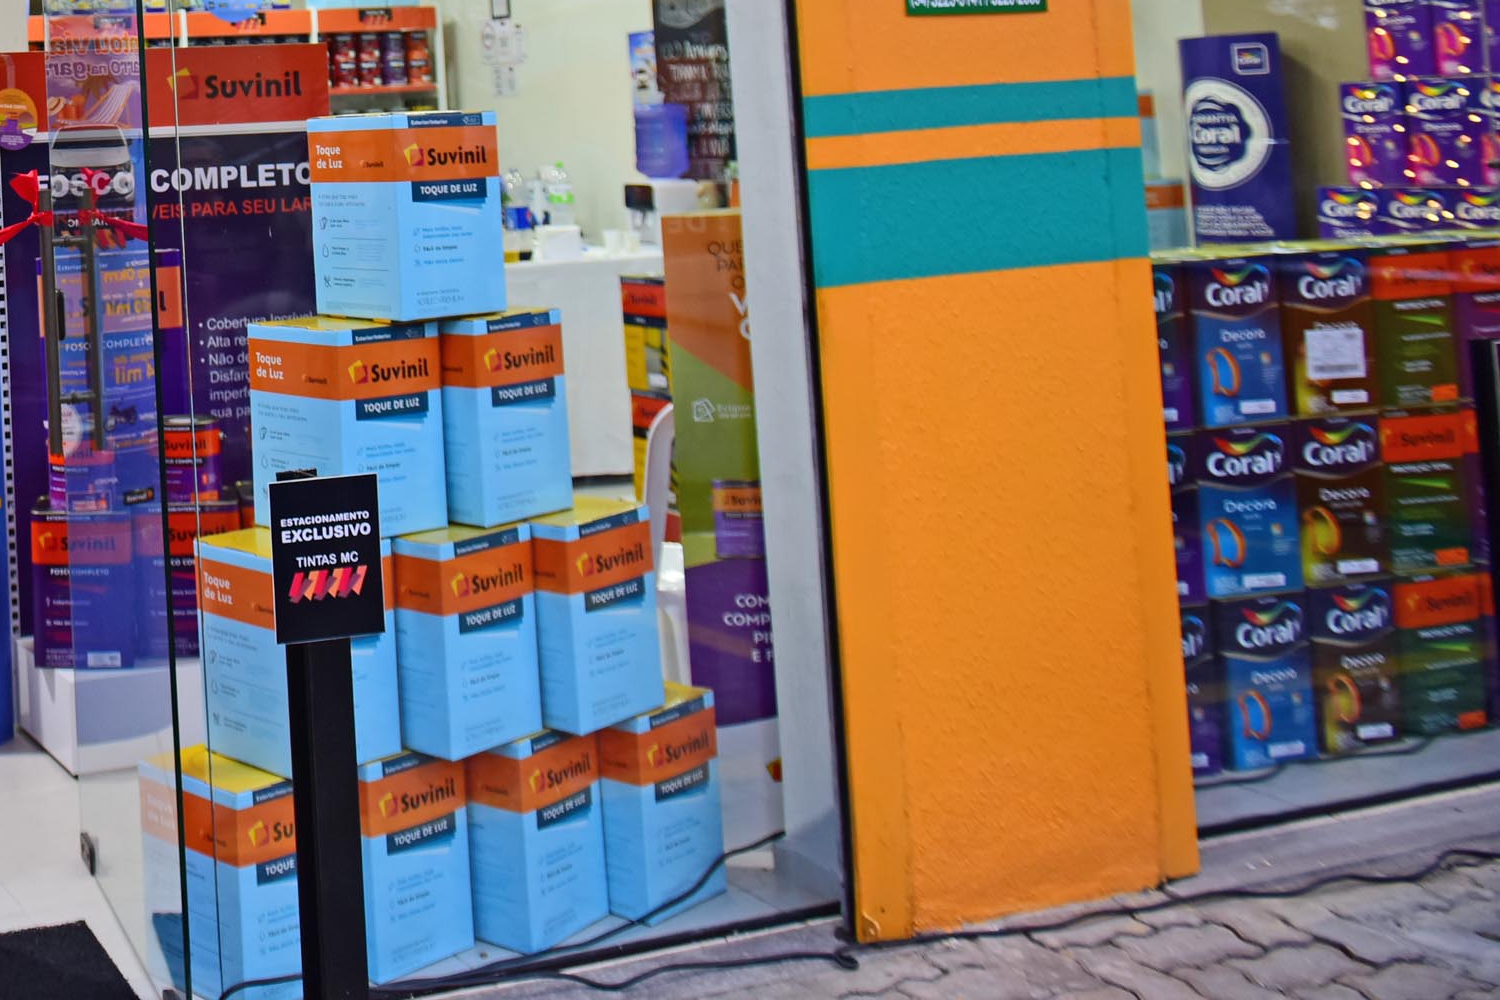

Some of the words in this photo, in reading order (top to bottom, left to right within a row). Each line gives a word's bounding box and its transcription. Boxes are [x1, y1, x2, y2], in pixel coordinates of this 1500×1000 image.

[204, 71, 302, 99] Suvinil
[316, 145, 341, 155] Toque
[428, 146, 487, 166] Suvinil
[316, 159, 327, 169] de
[328, 159, 343, 169] Luz
[420, 185, 448, 195] TOQUE
[450, 184, 461, 193] DE
[462, 183, 478, 193] LUZ
[192, 202, 238, 218] PARA
[242, 199, 276, 215] SEU
[1205, 280, 1264, 308] Coral
[1298, 275, 1357, 301] Coral
[207, 337, 231, 349] Alta
[209, 353, 234, 366] Não
[256, 352, 282, 367] Toque
[504, 345, 556, 370] Suvinil
[256, 368, 266, 378] de
[269, 368, 284, 380] Luz
[371, 360, 429, 383] Suvinil
[499, 388, 522, 402] TOQUE
[523, 386, 534, 396] DE
[535, 383, 548, 394] LUZ
[364, 401, 390, 413] TOQUE
[392, 400, 403, 410] DE
[405, 398, 420, 408] LUZ
[1302, 442, 1367, 467] Coral
[1206, 452, 1275, 478] Coral
[280, 510, 369, 528] ESTACIONAMENTO
[281, 522, 371, 544] EXCLUSIVO
[296, 552, 337, 569] TINTAS
[341, 551, 358, 563] MC
[595, 545, 645, 573] Suvinil
[204, 573, 231, 590] Toque
[472, 564, 524, 594] Suvinil
[204, 589, 216, 599] de
[217, 590, 233, 604] Luz
[591, 590, 615, 604] TOQUE
[616, 587, 627, 598] DE
[627, 584, 638, 594] LUZ
[466, 610, 491, 626] TOQUE
[492, 608, 503, 619] DE
[504, 605, 516, 616] LUZ
[1326, 606, 1384, 634] Coral
[1236, 621, 1296, 649] Coral
[665, 732, 709, 762] Suvinil
[547, 756, 591, 789] Suvinil
[401, 780, 455, 812] Suvinil
[394, 830, 421, 847] TOQUE
[423, 826, 434, 838] DE
[436, 820, 448, 833] LUZ
[265, 860, 295, 877] TOQUE
